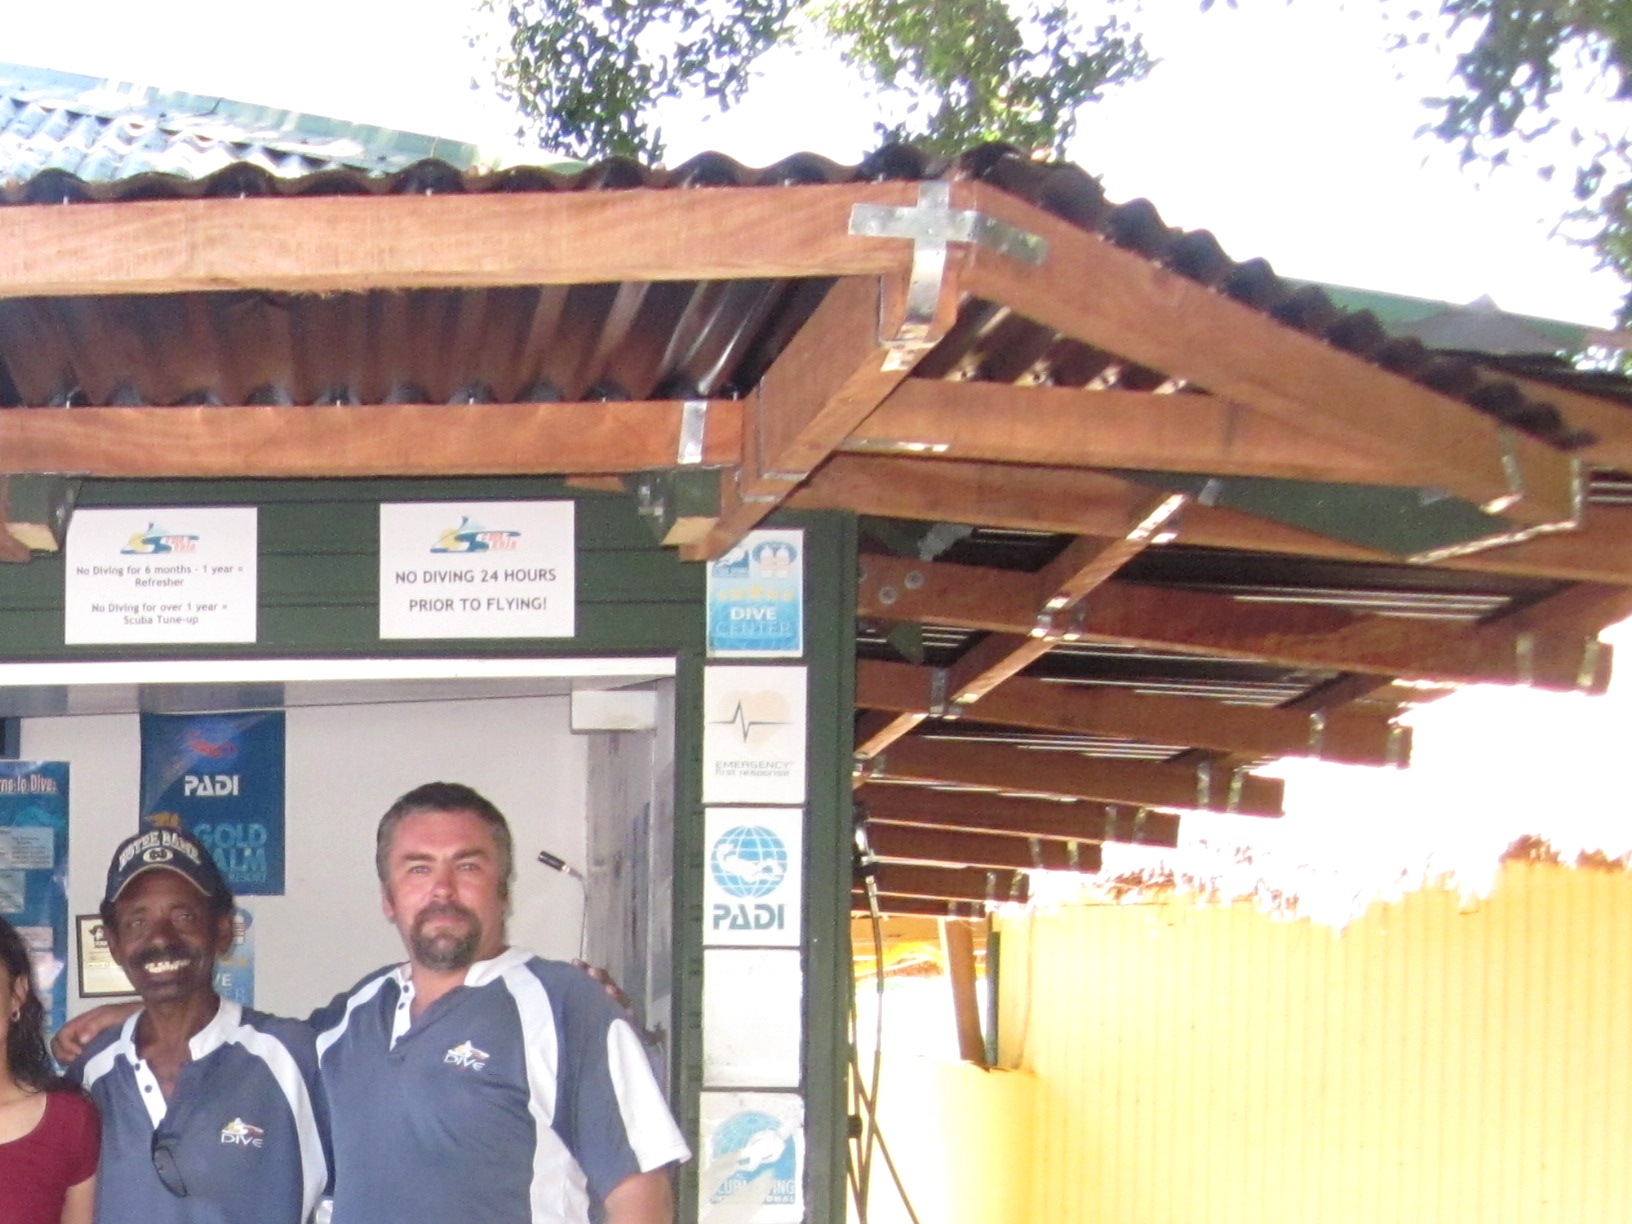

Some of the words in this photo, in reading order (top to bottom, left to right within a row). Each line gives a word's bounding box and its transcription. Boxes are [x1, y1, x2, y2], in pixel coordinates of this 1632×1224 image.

[77, 567, 89, 575] No
[93, 566, 124, 577] Diving
[127, 565, 140, 574] for
[145, 565, 151, 574] 6
[154, 565, 191, 574] months
[211, 566, 234, 576] year
[396, 571, 417, 584] NO
[423, 569, 475, 584] DIVING
[481, 569, 498, 583] 24
[504, 568, 557, 582] HOURS
[135, 578, 184, 587] Refresher
[92, 604, 105, 612] No
[108, 603, 139, 614] Diving
[142, 603, 157, 612] for
[160, 604, 182, 612] over
[195, 603, 218, 613] year
[409, 598, 454, 612] PRIOR
[459, 598, 481, 611] TO
[487, 597, 547, 611] FLYING!
[124, 615, 153, 625] Scuba
[157, 615, 199, 626] Tune-up
[731, 607, 777, 620] DIVE
[716, 621, 791, 636] CENTER
[715, 761, 789, 770] EMERGENCY
[184, 775, 239, 796] PADI
[193, 823, 267, 847] GOLD
[713, 903, 785, 931] PADI
[444, 1053, 485, 1071] DIVE
[221, 1133, 264, 1148] DIVE
